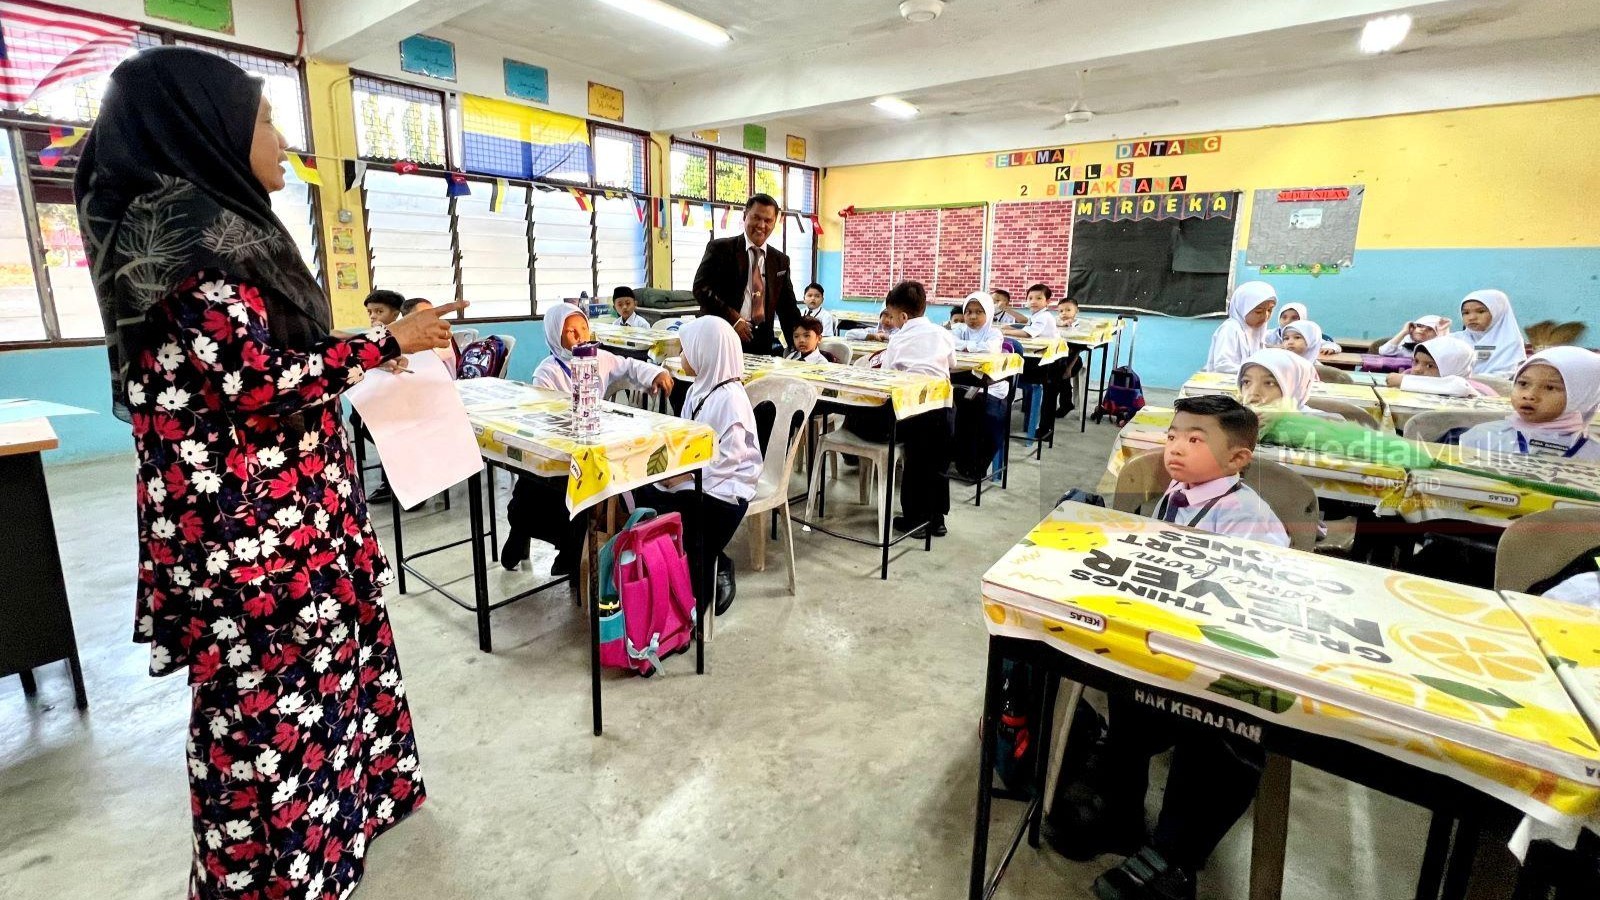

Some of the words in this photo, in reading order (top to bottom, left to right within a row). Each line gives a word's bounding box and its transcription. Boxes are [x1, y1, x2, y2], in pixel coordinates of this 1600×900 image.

[985, 148, 1077, 168] SELAMAT
[1119, 136, 1219, 158] DATANG
[1020, 184, 1028, 196] 2
[1046, 177, 1185, 197] BIJAKSANA
[1057, 163, 1131, 180] KELAS
[1077, 196, 1227, 215] MERDEKA
[1117, 534, 1355, 595] COMFORT
[1128, 551, 1218, 580] from
[1159, 530, 1302, 569] ONES
[1069, 568, 1212, 616] THINGS
[1083, 549, 1384, 648] NEVER
[1220, 574, 1322, 604] come
[1070, 611, 1100, 627] KELAS
[1226, 612, 1393, 664] GREAT
[1134, 688, 1166, 711] HAK
[1170, 700, 1261, 744] KERAJAAN
